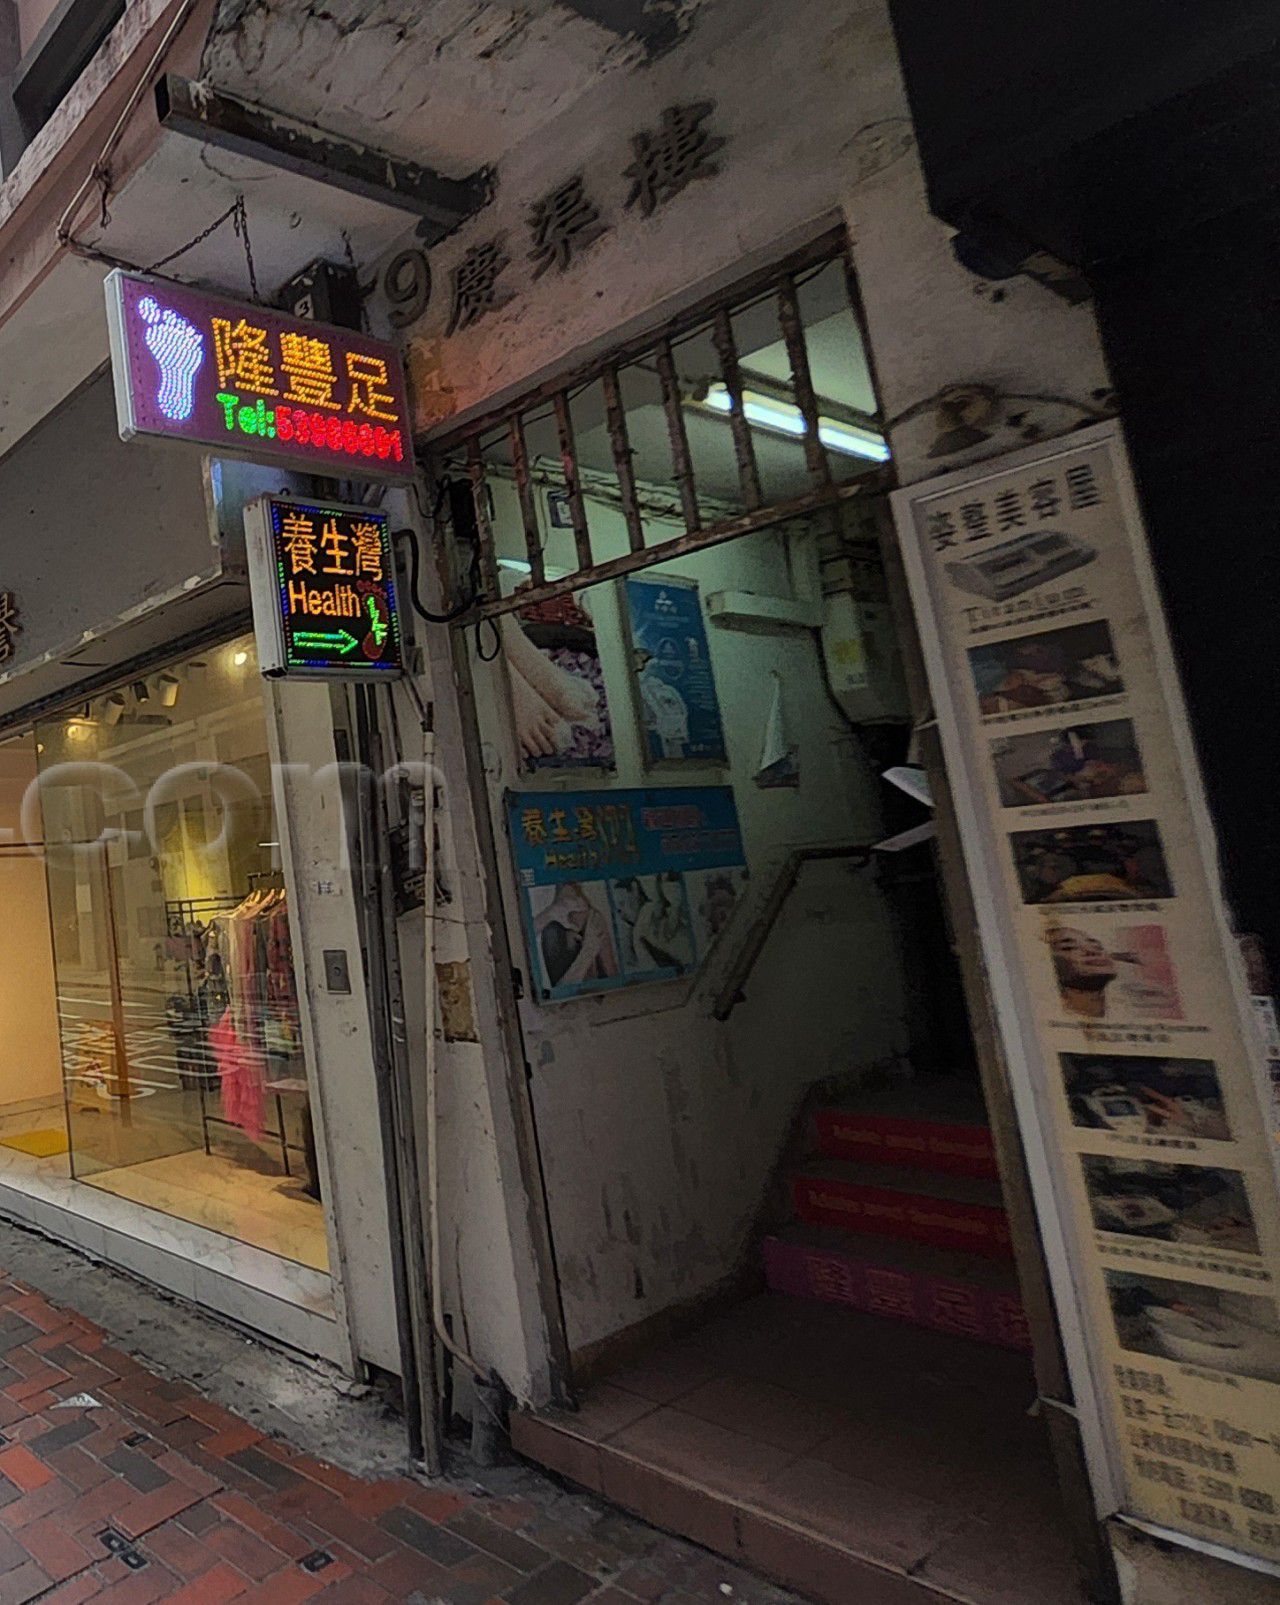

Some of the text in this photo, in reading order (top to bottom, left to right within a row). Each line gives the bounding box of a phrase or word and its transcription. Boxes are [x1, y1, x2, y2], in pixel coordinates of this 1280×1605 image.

[384, 247, 432, 331] 9
[211, 317, 400, 423] 隆豐足
[288, 579, 362, 618] Health
